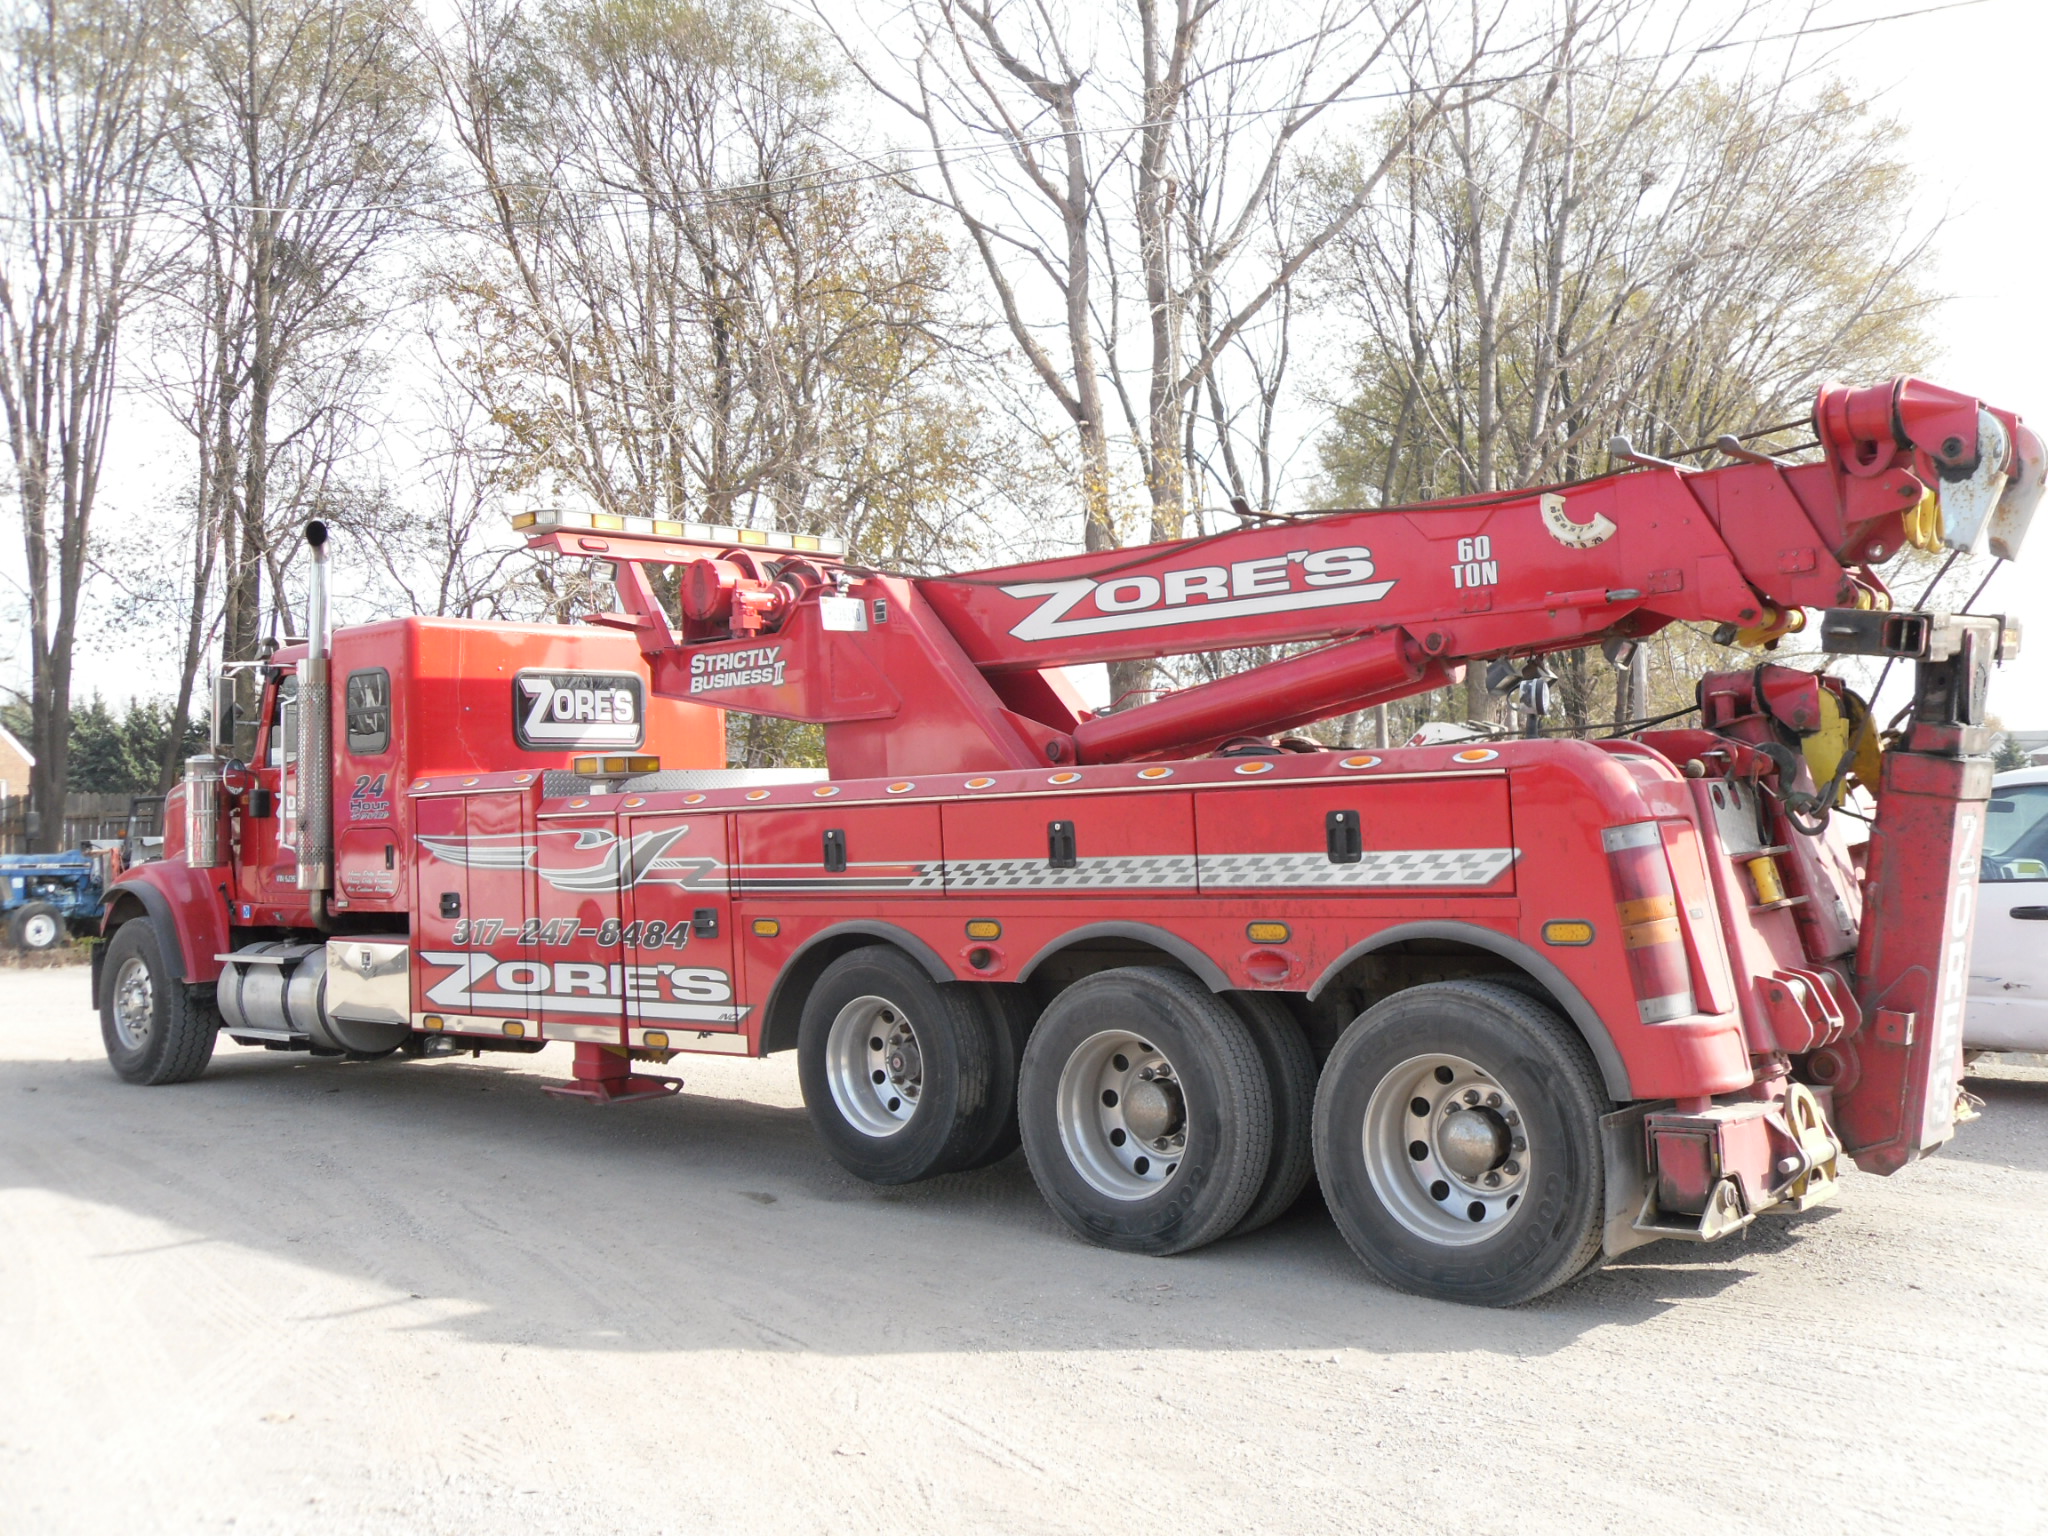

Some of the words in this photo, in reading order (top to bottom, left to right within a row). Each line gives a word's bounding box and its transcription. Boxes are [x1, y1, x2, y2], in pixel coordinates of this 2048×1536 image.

[1457, 535, 1490, 562] 60
[1450, 560, 1499, 589] TON
[1000, 547, 1398, 641] ZORE'S
[690, 646, 780, 675] STRICTLY
[690, 669, 773, 694] BUSINESS
[519, 678, 640, 743] ZORE'S
[351, 773, 388, 800] 24
[349, 800, 390, 812] Hour
[452, 918, 691, 949] 317-247-8484
[420, 952, 751, 1021] ZORE'S
